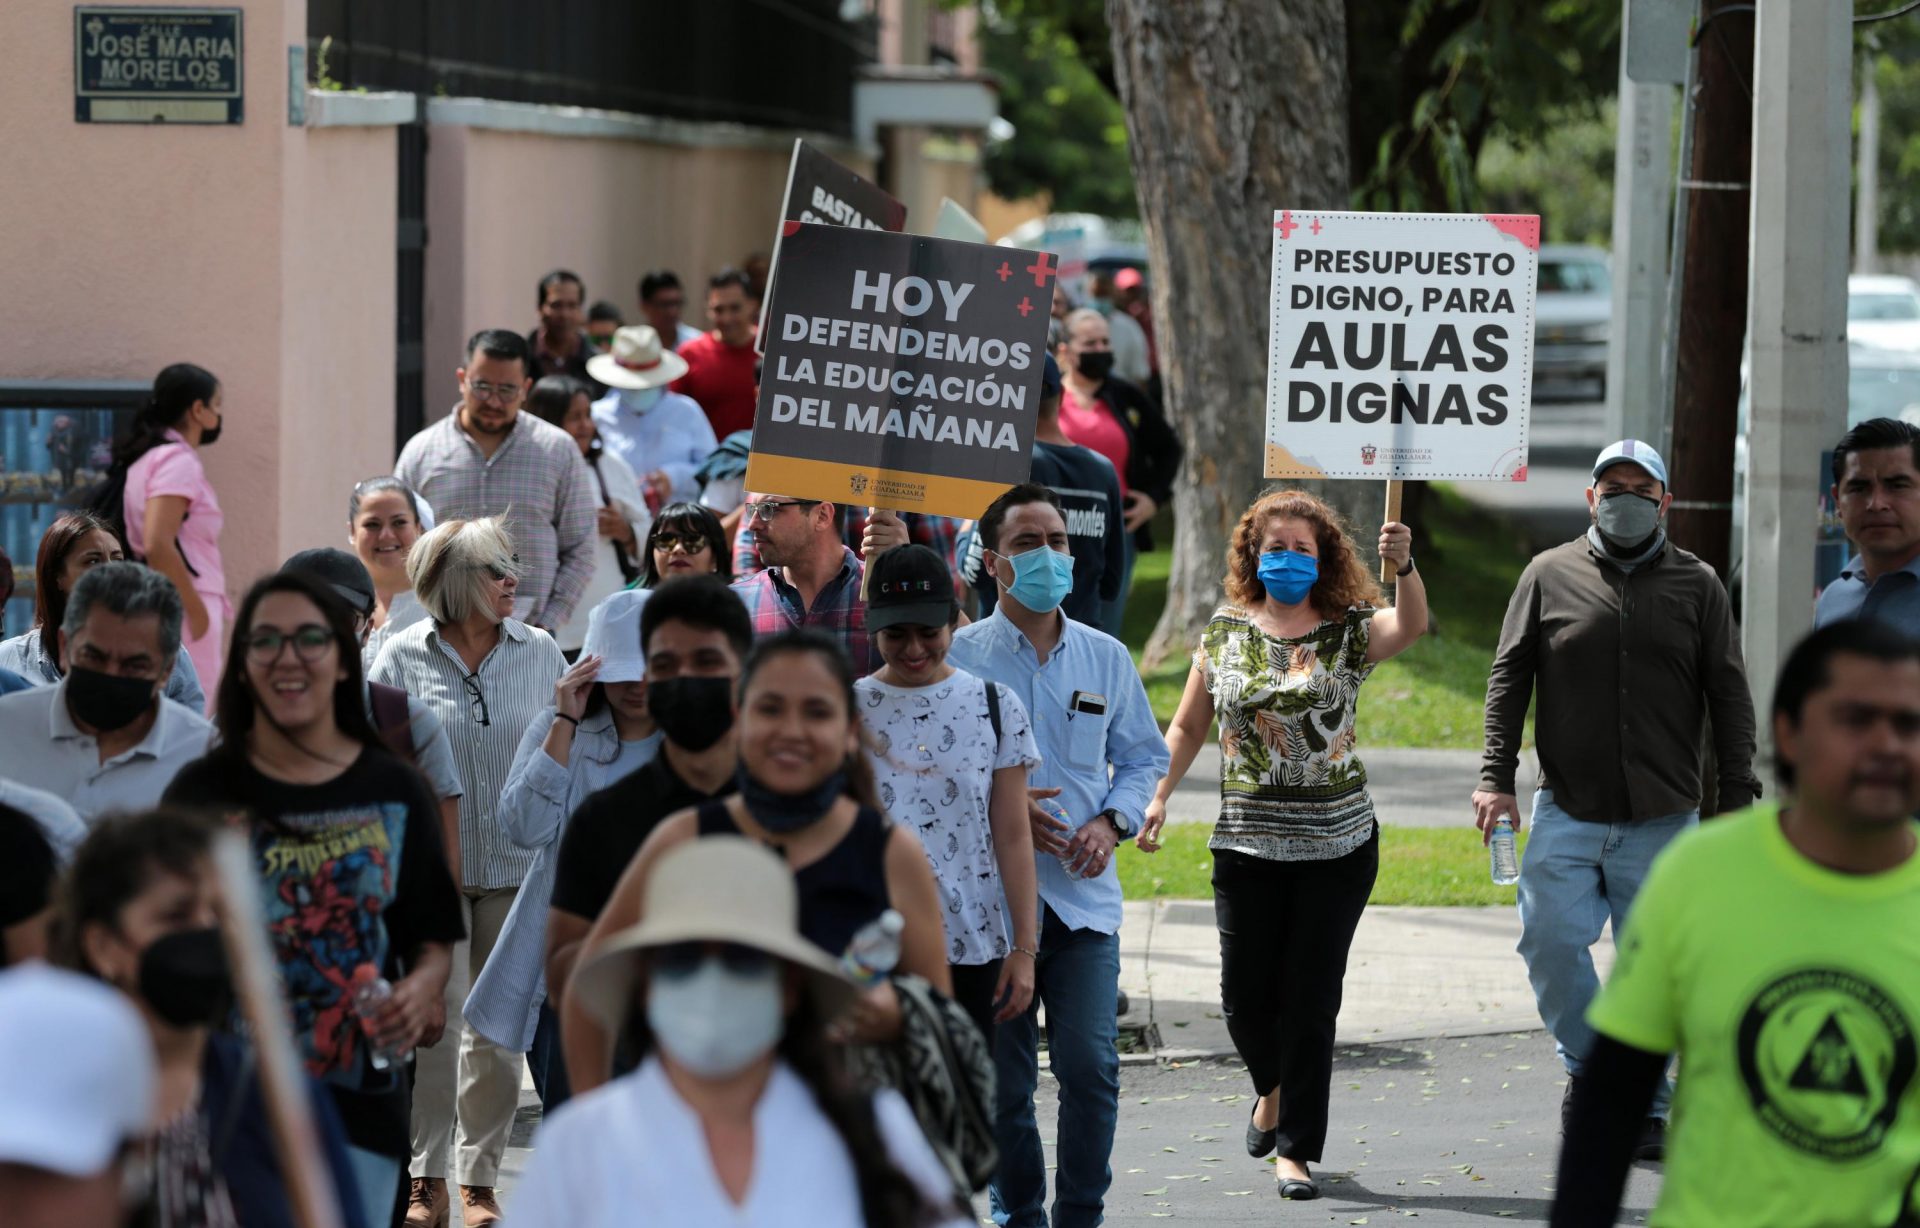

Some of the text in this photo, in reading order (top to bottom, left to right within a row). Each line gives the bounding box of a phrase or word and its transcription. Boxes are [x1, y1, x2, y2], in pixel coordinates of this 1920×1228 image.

[157, 36, 235, 59] MARIA
[102, 58, 221, 82] MORELOS
[812, 185, 862, 229] BASTA
[1294, 249, 1515, 276] PRESUPUESTO
[851, 269, 975, 322] HOY
[1290, 284, 1515, 317] DIGNO, PARA
[782, 313, 1031, 370] DEFENDEMOS
[1290, 322, 1509, 373] AULAS
[776, 355, 1026, 410] LA EDUCACIÓN
[1288, 381, 1508, 426] DIGNAS
[771, 394, 1020, 452] DEL MAÑANA
[1061, 503, 1105, 538] montes
